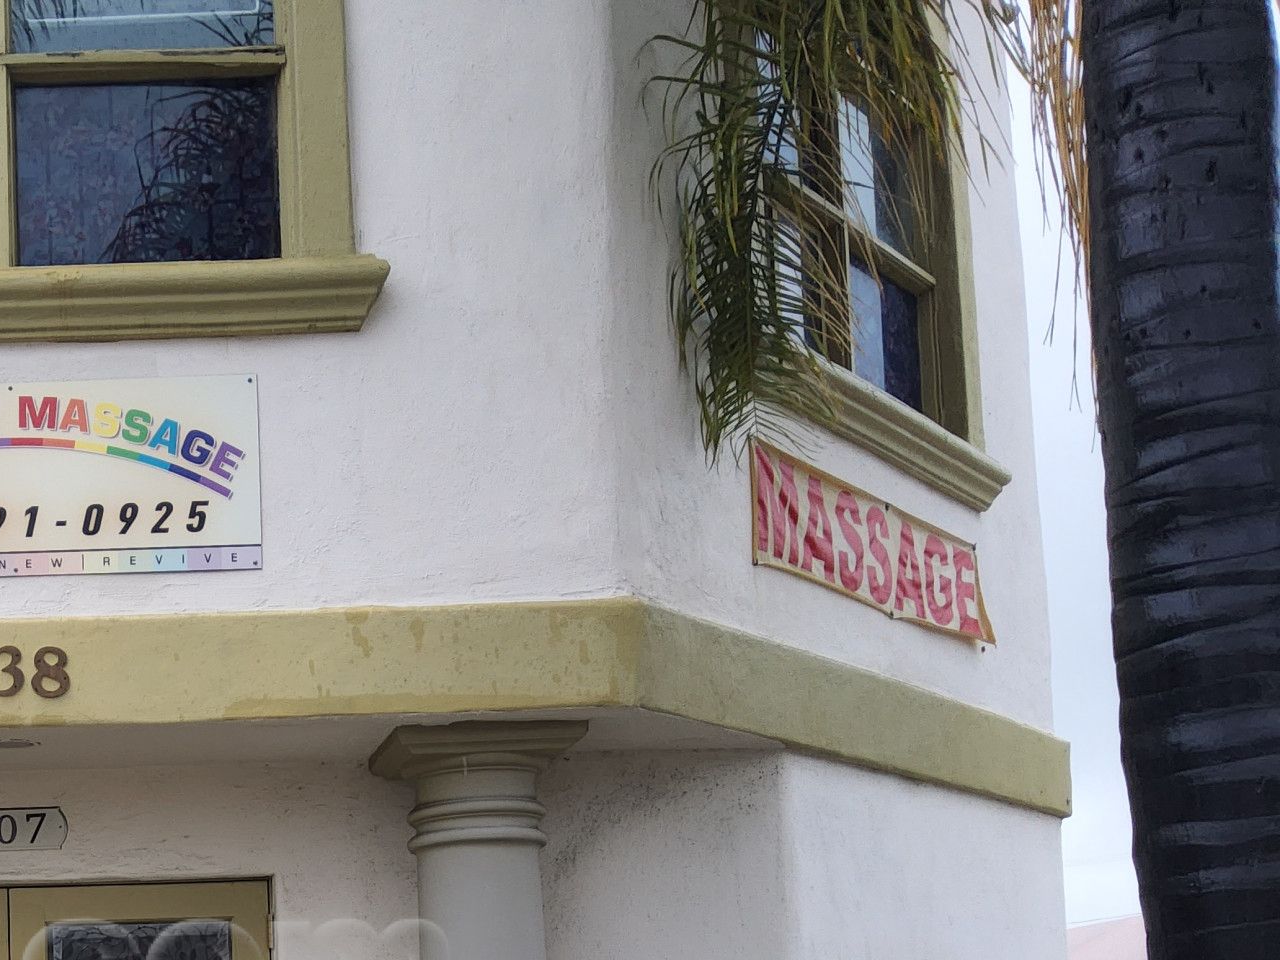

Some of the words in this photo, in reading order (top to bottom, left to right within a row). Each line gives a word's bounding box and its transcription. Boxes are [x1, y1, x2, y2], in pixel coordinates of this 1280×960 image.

[18, 395, 246, 482] MASSAGE
[102, 553, 238, 566] REVIVE
[756, 445, 984, 639] MASSAGE
